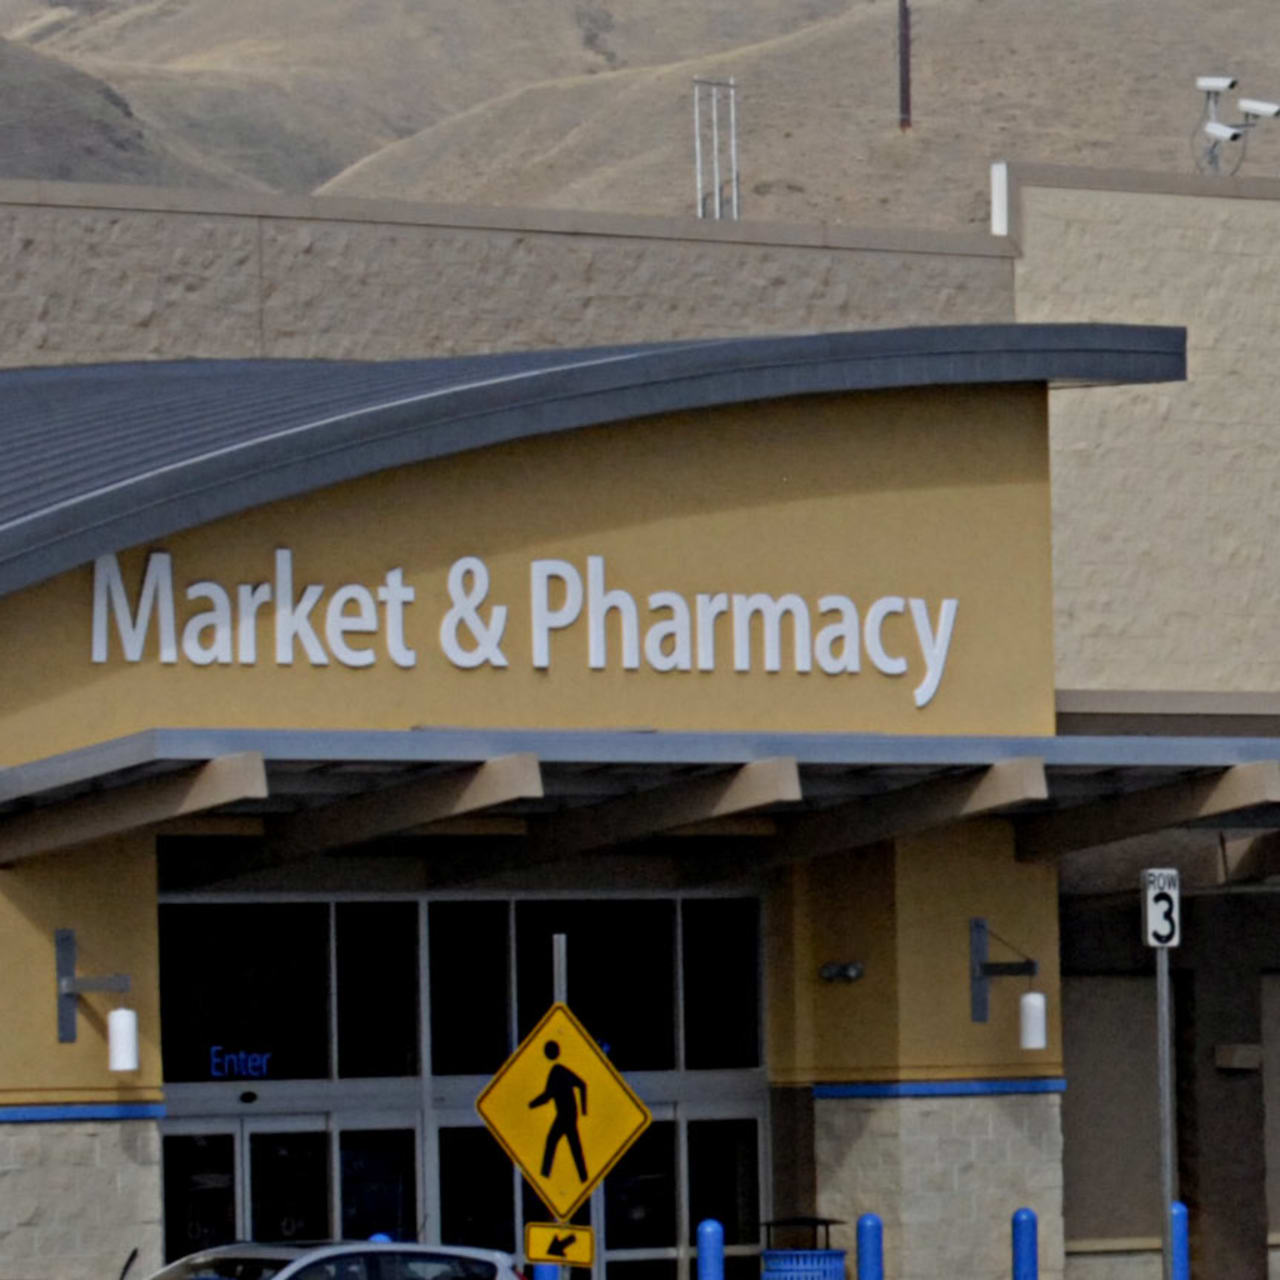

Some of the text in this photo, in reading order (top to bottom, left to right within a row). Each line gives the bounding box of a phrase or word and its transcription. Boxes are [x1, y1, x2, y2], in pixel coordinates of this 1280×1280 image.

[91, 548, 958, 707] Market & Pharmacy
[1148, 873, 1178, 891] ROW
[1152, 892, 1176, 945] 3
[209, 1045, 272, 1077] Enter
